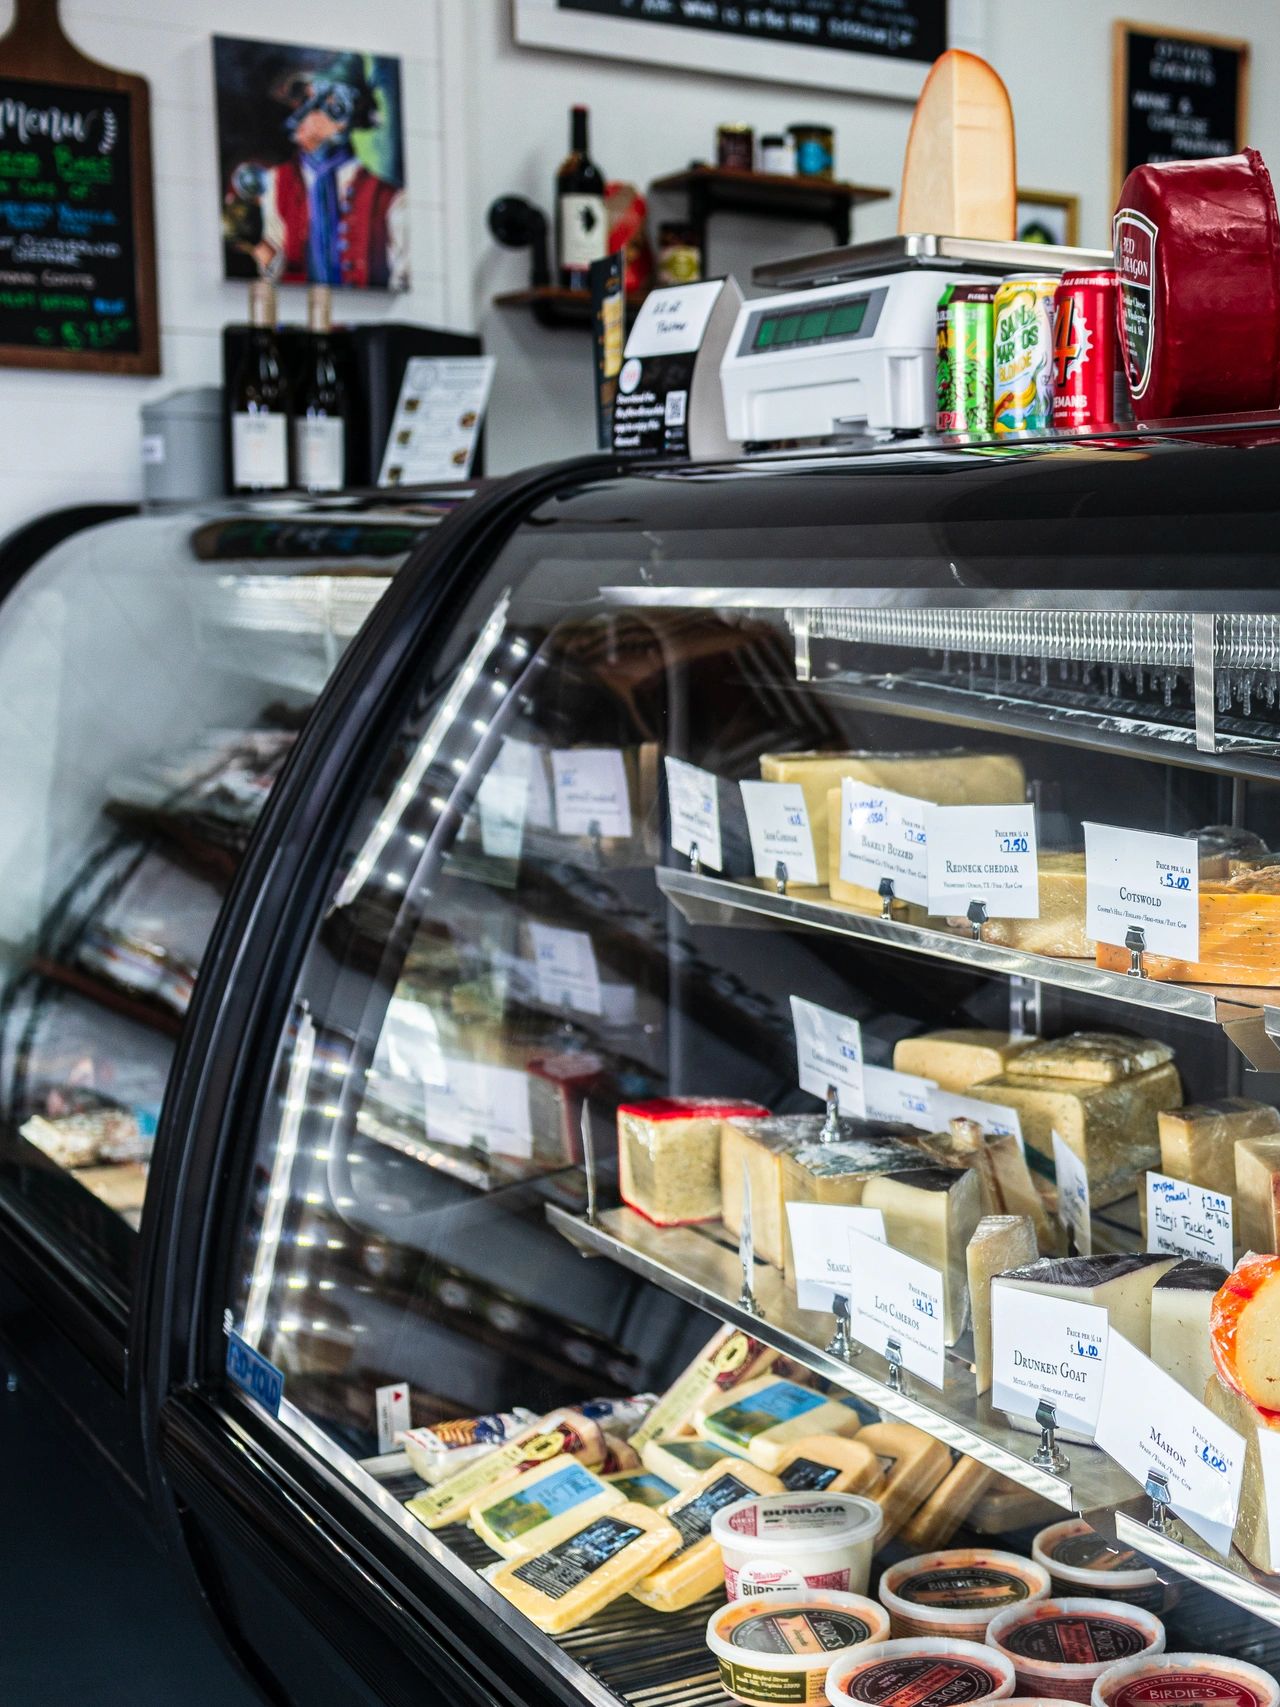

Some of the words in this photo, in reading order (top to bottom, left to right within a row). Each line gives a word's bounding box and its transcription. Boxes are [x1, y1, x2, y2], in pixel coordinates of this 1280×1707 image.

[887, 843, 914, 860] BUZZED
[1000, 838, 1028, 853] $7.50
[946, 860, 982, 873] REDNECK
[984, 864, 1020, 873] CHEDDAR
[1156, 861, 1170, 871] PRICE
[1171, 864, 1179, 872] PER
[1160, 873, 1190, 890] $5.00
[1120, 887, 1162, 907] COTSWOLD
[1202, 1193, 1226, 1211] $7.99
[1181, 1215, 1214, 1239] Truckle
[827, 1259, 851, 1273] SEASCA
[875, 1295, 888, 1313] LOS
[889, 1303, 920, 1330] CAMEROS
[912, 1298, 934, 1317] $4.13
[1066, 1327, 1081, 1338] PRICE
[1081, 1332, 1090, 1340] PER
[1070, 1340, 1099, 1357] $6.00
[1014, 1350, 1058, 1375] DRUNKEN
[1060, 1362, 1087, 1383] GOAT
[1192, 1425, 1208, 1445] PRICE
[1149, 1425, 1187, 1468] MAHON
[1195, 1445, 1227, 1473] $6.00
[762, 1505, 846, 1517] BURRATA
[928, 1578, 991, 1592] BIRDIE'S
[1149, 1688, 1217, 1700] BIRDIE'S
[1201, 1678, 1240, 1694] TRADITION
